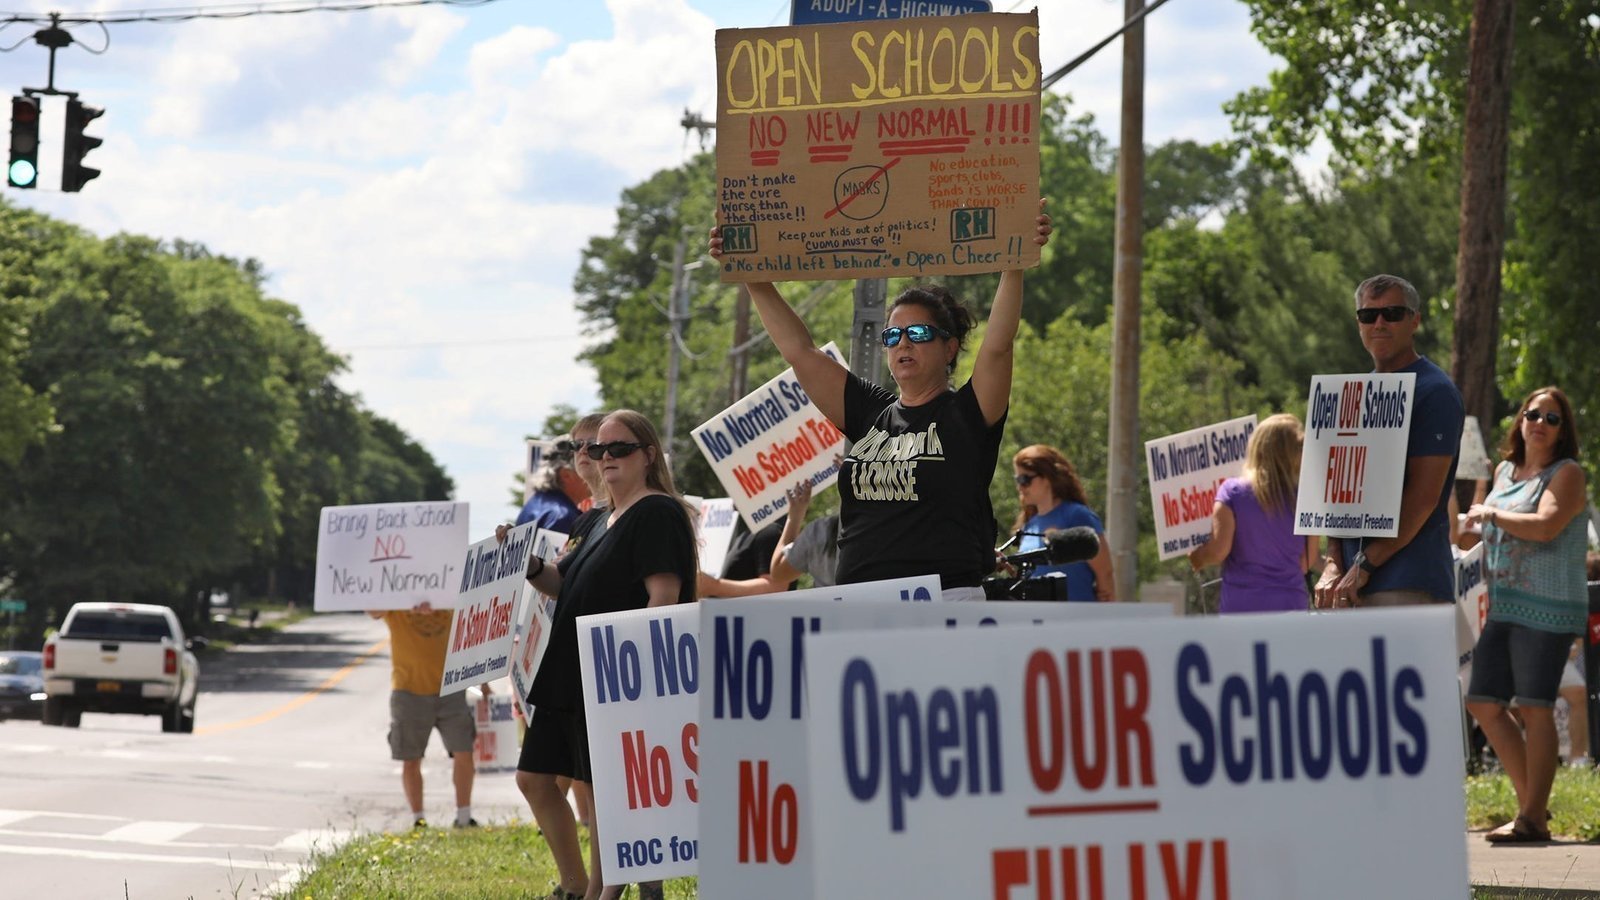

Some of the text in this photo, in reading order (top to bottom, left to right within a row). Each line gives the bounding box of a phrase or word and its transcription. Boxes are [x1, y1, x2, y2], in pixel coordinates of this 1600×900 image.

[726, 25, 1038, 109] OPEN SCHOOLS
[750, 115, 788, 149] NO
[806, 111, 861, 143] NEW
[878, 107, 976, 138] NORMAL
[928, 170, 1005, 188] sports, clubs,
[929, 154, 1020, 172] No education,
[721, 188, 781, 201] the cure
[723, 173, 796, 188] Don't make
[842, 179, 881, 197] MASKS
[928, 185, 963, 198] bands
[987, 184, 1028, 195] WORSE
[724, 212, 746, 223] the
[759, 200, 788, 210] than
[929, 200, 959, 210] THAN
[966, 198, 1001, 208] COVID
[722, 226, 751, 251] RH
[778, 231, 806, 242] Keep
[810, 230, 826, 238] our
[856, 225, 870, 234] out
[874, 222, 885, 233] of
[955, 208, 989, 240] RH
[757, 255, 792, 271] child
[797, 255, 825, 271] left
[907, 250, 946, 272] Open
[952, 244, 1002, 265] Cheer
[805, 239, 839, 250] CUOMO
[842, 237, 868, 247] MUST
[871, 236, 884, 247] GO
[700, 428, 733, 463] No
[722, 387, 786, 448] Normal
[1311, 380, 1407, 439] Open OUR Schools
[732, 465, 766, 499] No
[756, 427, 817, 484] School
[1150, 447, 1168, 482] No
[1168, 434, 1211, 477] Normal
[1323, 446, 1367, 504] FULLY!
[327, 503, 456, 540] Bring Back School
[751, 506, 773, 524] ROC
[772, 495, 788, 511] for
[1162, 492, 1180, 528] No
[1299, 512, 1394, 530] ROC for Educational Freedom
[373, 534, 406, 558] NO
[459, 549, 474, 594] No
[470, 544, 500, 590] Normal
[496, 525, 533, 581] School?
[1163, 540, 1179, 554] ROC
[1179, 537, 1190, 549] for
[452, 608, 466, 654] No
[463, 598, 493, 651] School
[487, 589, 517, 642] Taxes!
[443, 671, 454, 687] ROC
[460, 658, 488, 681] Educational
[486, 654, 508, 673] Freedom
[591, 624, 642, 704] No
[713, 615, 773, 721] No
[840, 656, 1004, 834] Open
[1023, 646, 1157, 793] OUR
[1175, 635, 1430, 787] Schools
[621, 729, 673, 810] No
[738, 760, 798, 866] No
[616, 837, 664, 869] ROC
